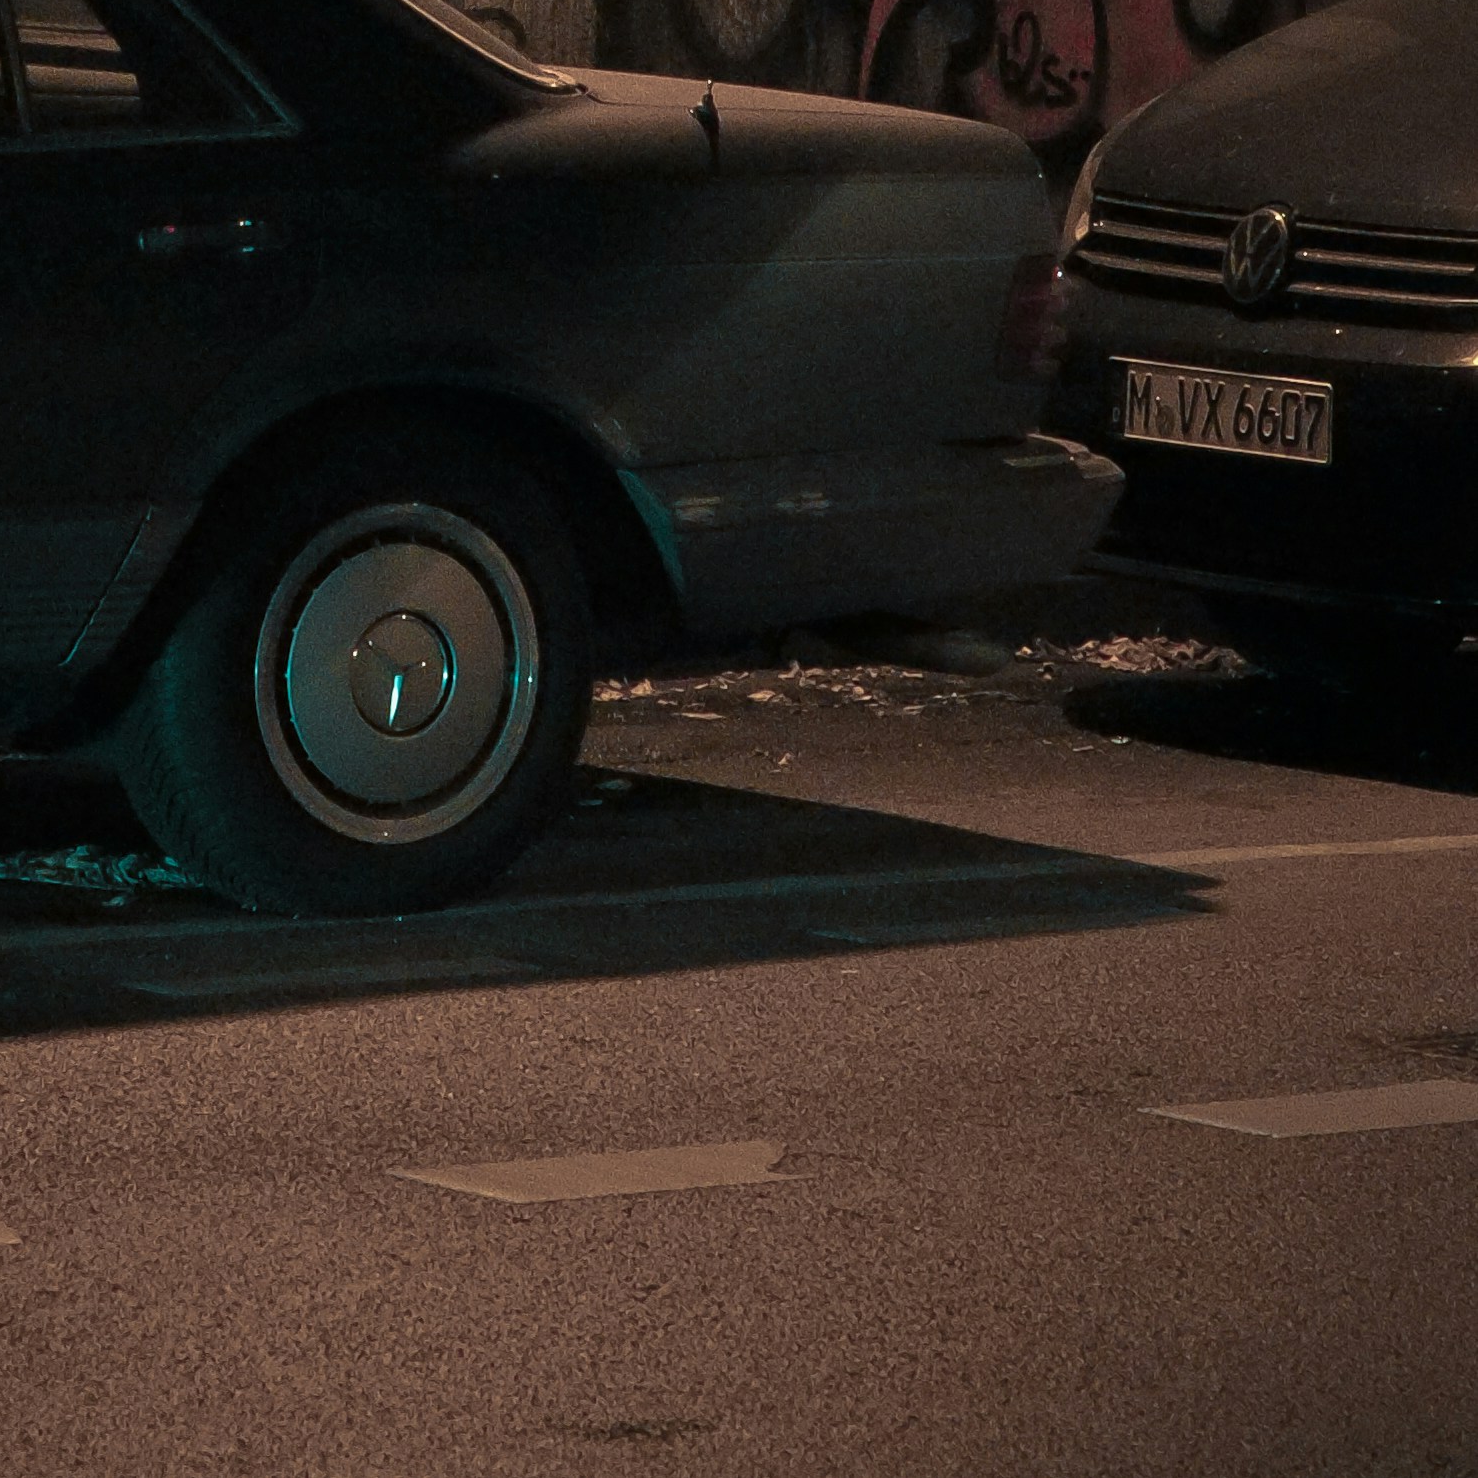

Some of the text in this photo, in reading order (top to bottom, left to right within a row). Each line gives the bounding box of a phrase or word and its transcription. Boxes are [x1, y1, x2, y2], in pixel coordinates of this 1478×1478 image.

[1127, 370, 1327, 451] M VX 6607
